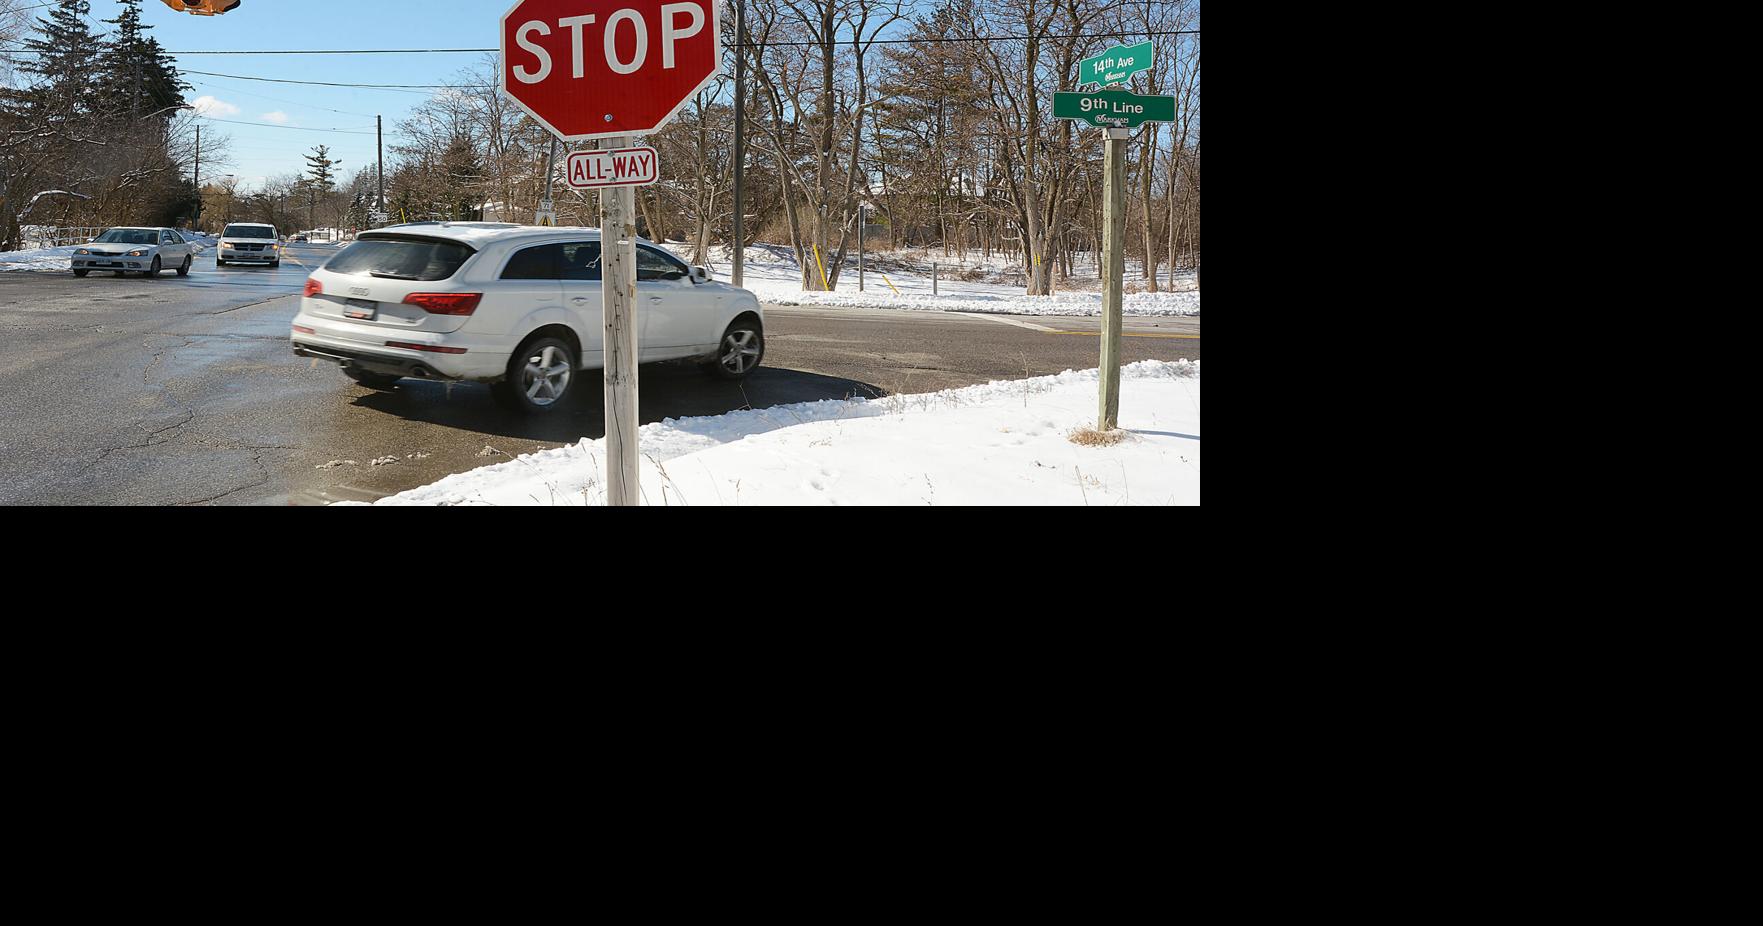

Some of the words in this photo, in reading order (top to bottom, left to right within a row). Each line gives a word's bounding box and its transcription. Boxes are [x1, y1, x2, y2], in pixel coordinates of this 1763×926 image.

[512, 2, 705, 85] STOP
[1093, 57, 1114, 74] 14th
[1116, 57, 1134, 69] Ave
[1080, 98, 1108, 112] 9th
[1113, 102, 1143, 114] Line
[573, 154, 650, 181] ALL-WAY
